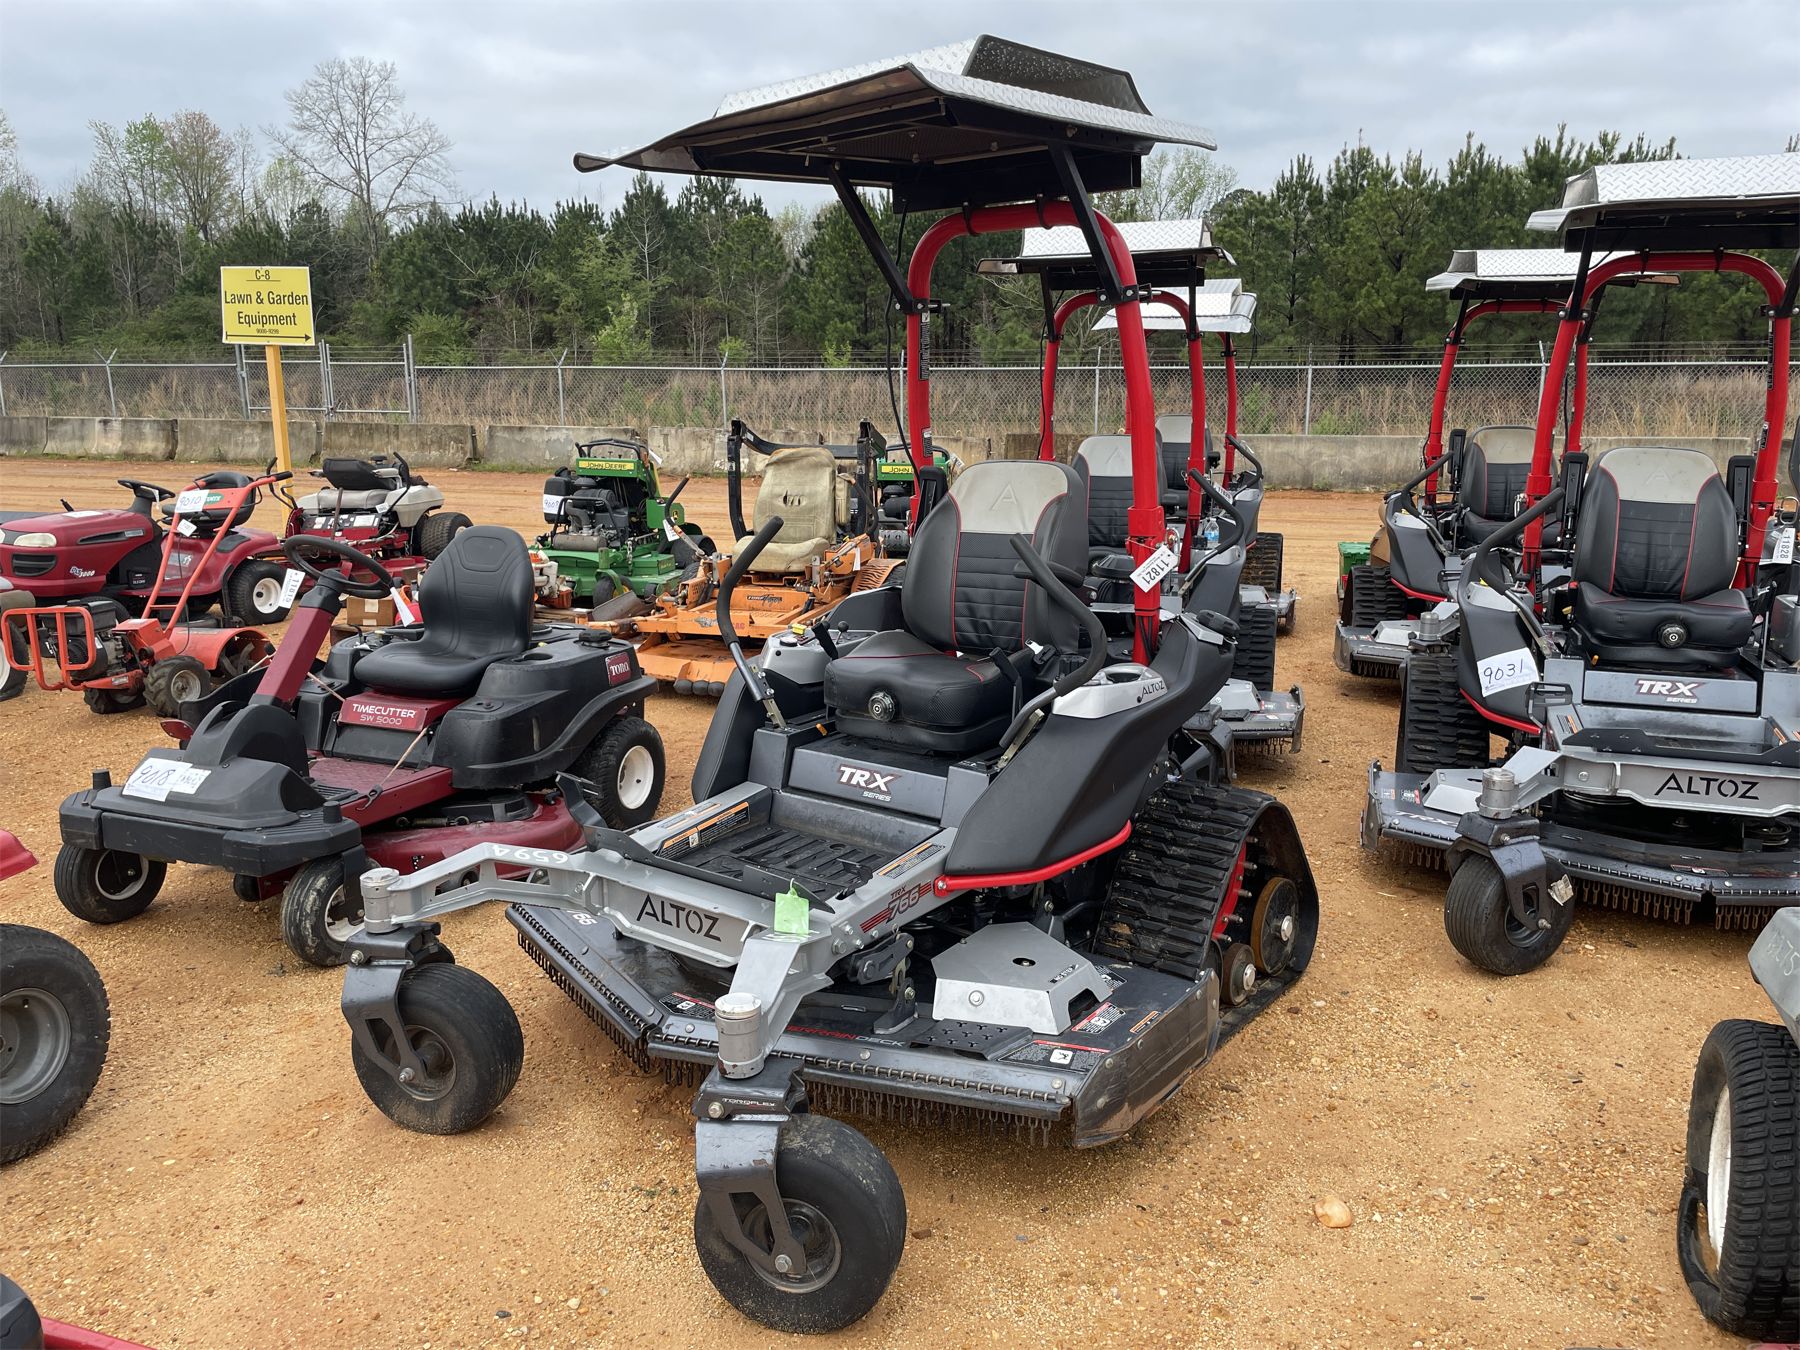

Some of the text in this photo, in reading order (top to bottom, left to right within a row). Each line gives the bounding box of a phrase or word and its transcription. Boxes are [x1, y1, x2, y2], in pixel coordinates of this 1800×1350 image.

[255, 270, 270, 280] C-8
[224, 291, 308, 305] Lawn & Garden
[237, 312, 297, 327] Equipment
[586, 461, 627, 470] JOHN DEERE
[1780, 535, 1791, 559] 11828
[1141, 559, 1170, 585] 11821
[610, 661, 630, 676] TORO
[1483, 658, 1524, 685] 9031
[1141, 679, 1165, 700] ALTOZ
[1637, 679, 1700, 697] TRX
[1665, 696, 1699, 704] SERIES
[352, 703, 416, 719] TIMECUTTER
[360, 714, 403, 725] SW 5000
[132, 764, 176, 786] 9018
[839, 765, 897, 792] TRX
[1653, 772, 1760, 801] ALTOZ
[862, 790, 892, 802] SERIES
[493, 844, 569, 865] 6594
[890, 885, 907, 900] TRX
[887, 884, 921, 920] 766
[635, 893, 722, 943] ALTOZ
